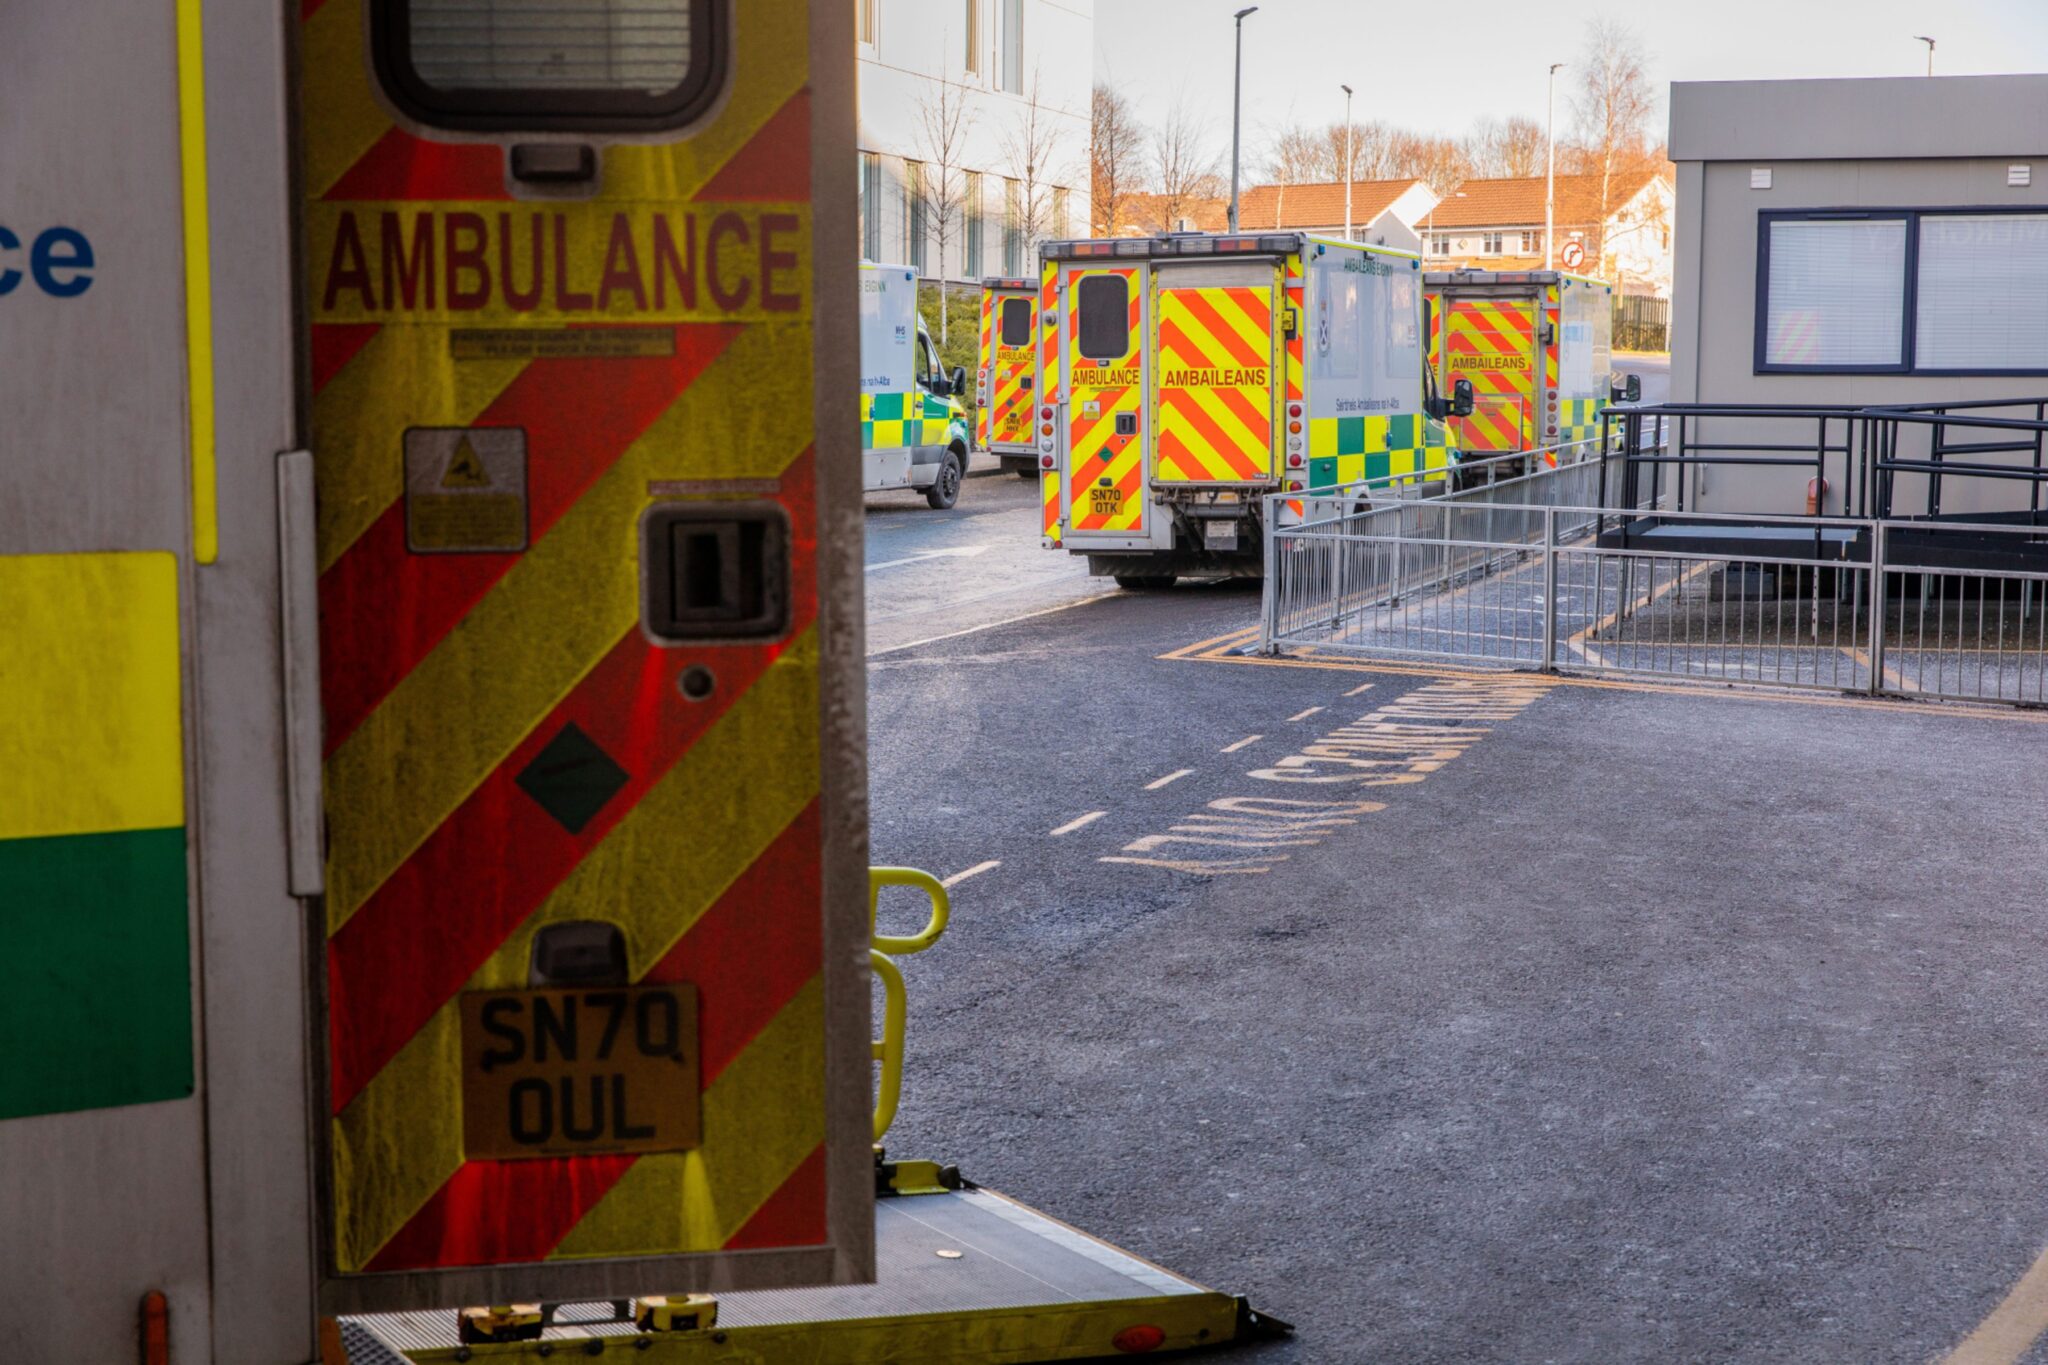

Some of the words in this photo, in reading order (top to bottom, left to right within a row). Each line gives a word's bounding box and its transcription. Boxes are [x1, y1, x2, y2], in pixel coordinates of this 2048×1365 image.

[322, 211, 801, 313] AMBULANCE
[997, 351, 1035, 361] AMBULANCE
[1452, 357, 1525, 369] AMBAILEANS
[1072, 369, 1139, 385] AMBULANCE
[1165, 369, 1266, 386] AMBAILEANS
[1092, 489, 1121, 501] SN70
[1095, 502, 1118, 513] OTK
[509, 1073, 656, 1145] OUL
